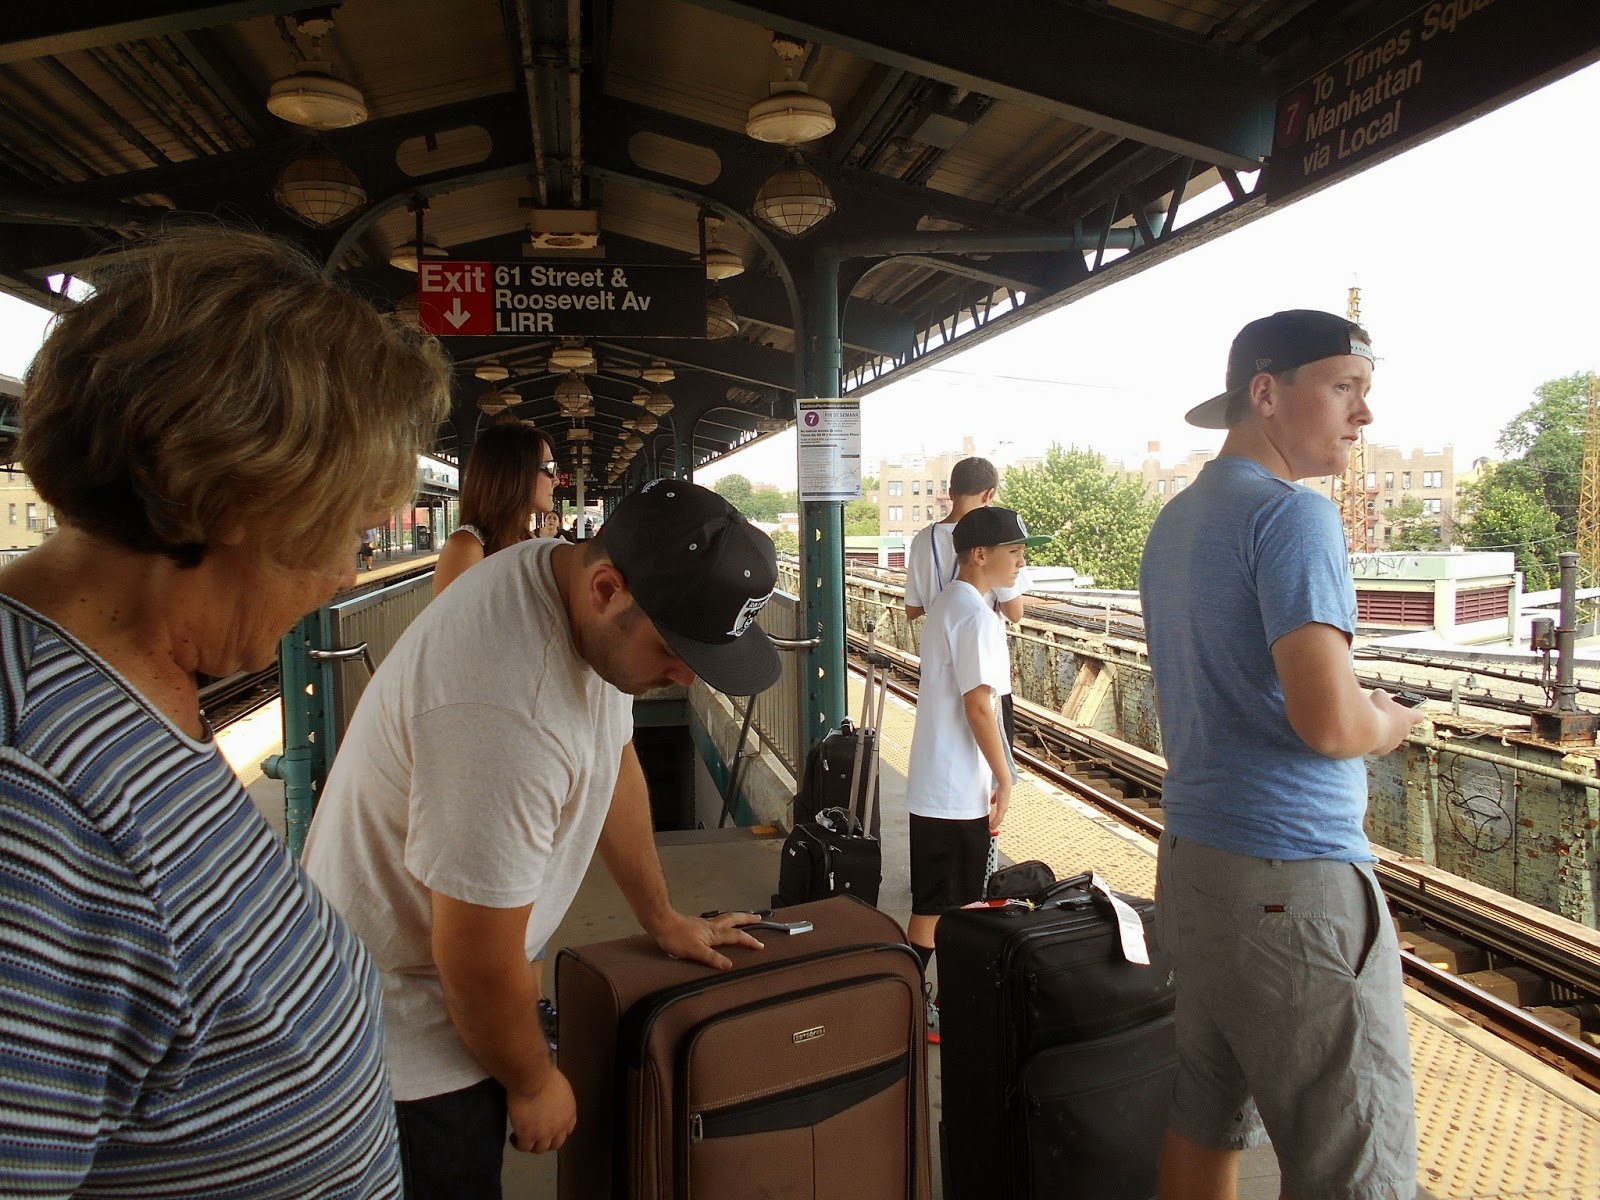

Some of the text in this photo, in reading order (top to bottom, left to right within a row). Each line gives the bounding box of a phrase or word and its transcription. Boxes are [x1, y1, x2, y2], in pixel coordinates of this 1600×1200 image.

[1312, 71, 1335, 105] To
[1343, 28, 1411, 87] Times
[1305, 59, 1422, 143] Manhattan
[1286, 102, 1300, 136] 7
[1303, 99, 1401, 176] via Local
[421, 264, 486, 293] Exit
[495, 266, 628, 288] 61 Street &
[495, 289, 651, 311] Roosevelt Av
[495, 312, 554, 332] LIRR
[809, 415, 815, 424] 7
